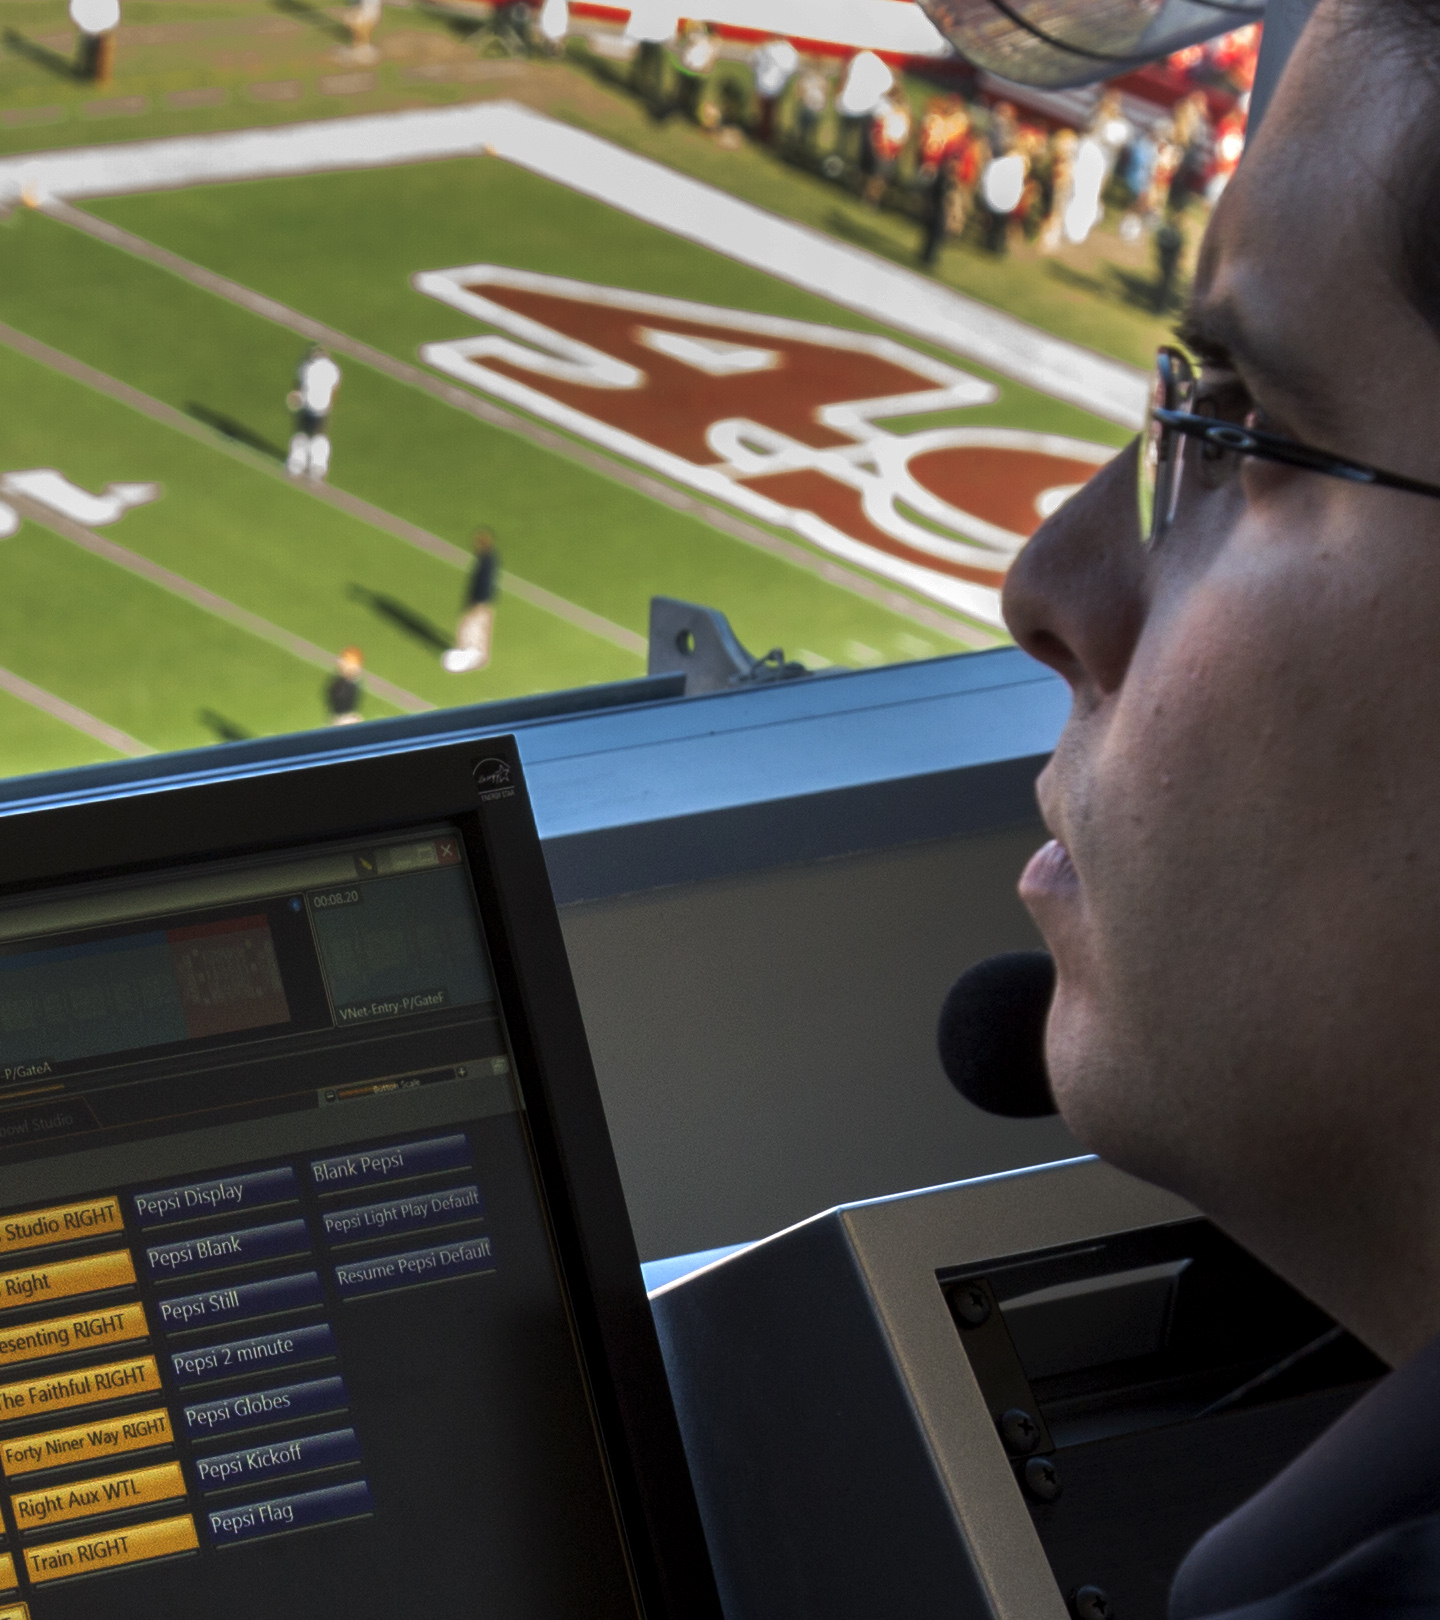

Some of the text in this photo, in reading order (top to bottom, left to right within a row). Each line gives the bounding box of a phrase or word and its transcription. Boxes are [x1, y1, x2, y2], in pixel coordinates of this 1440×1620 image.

[311, 1148, 405, 1183] Blank Pepsi
[135, 1179, 246, 1221] Pepsi Display
[3, 1214, 61, 1242] Studio
[62, 1204, 116, 1230] RIGHT
[147, 1233, 243, 1272] Pepsi Blank
[3, 1271, 52, 1300] Right
[160, 1288, 241, 1326] Pepsi Still
[71, 1313, 127, 1340] RIGHT
[172, 1334, 295, 1380] Pepsi 2 minute
[26, 1374, 93, 1405] Faithful
[93, 1364, 149, 1391] RIGHT
[16, 1476, 140, 1522] Right Aux WTL
[29, 1535, 130, 1573] Train RIGHT
